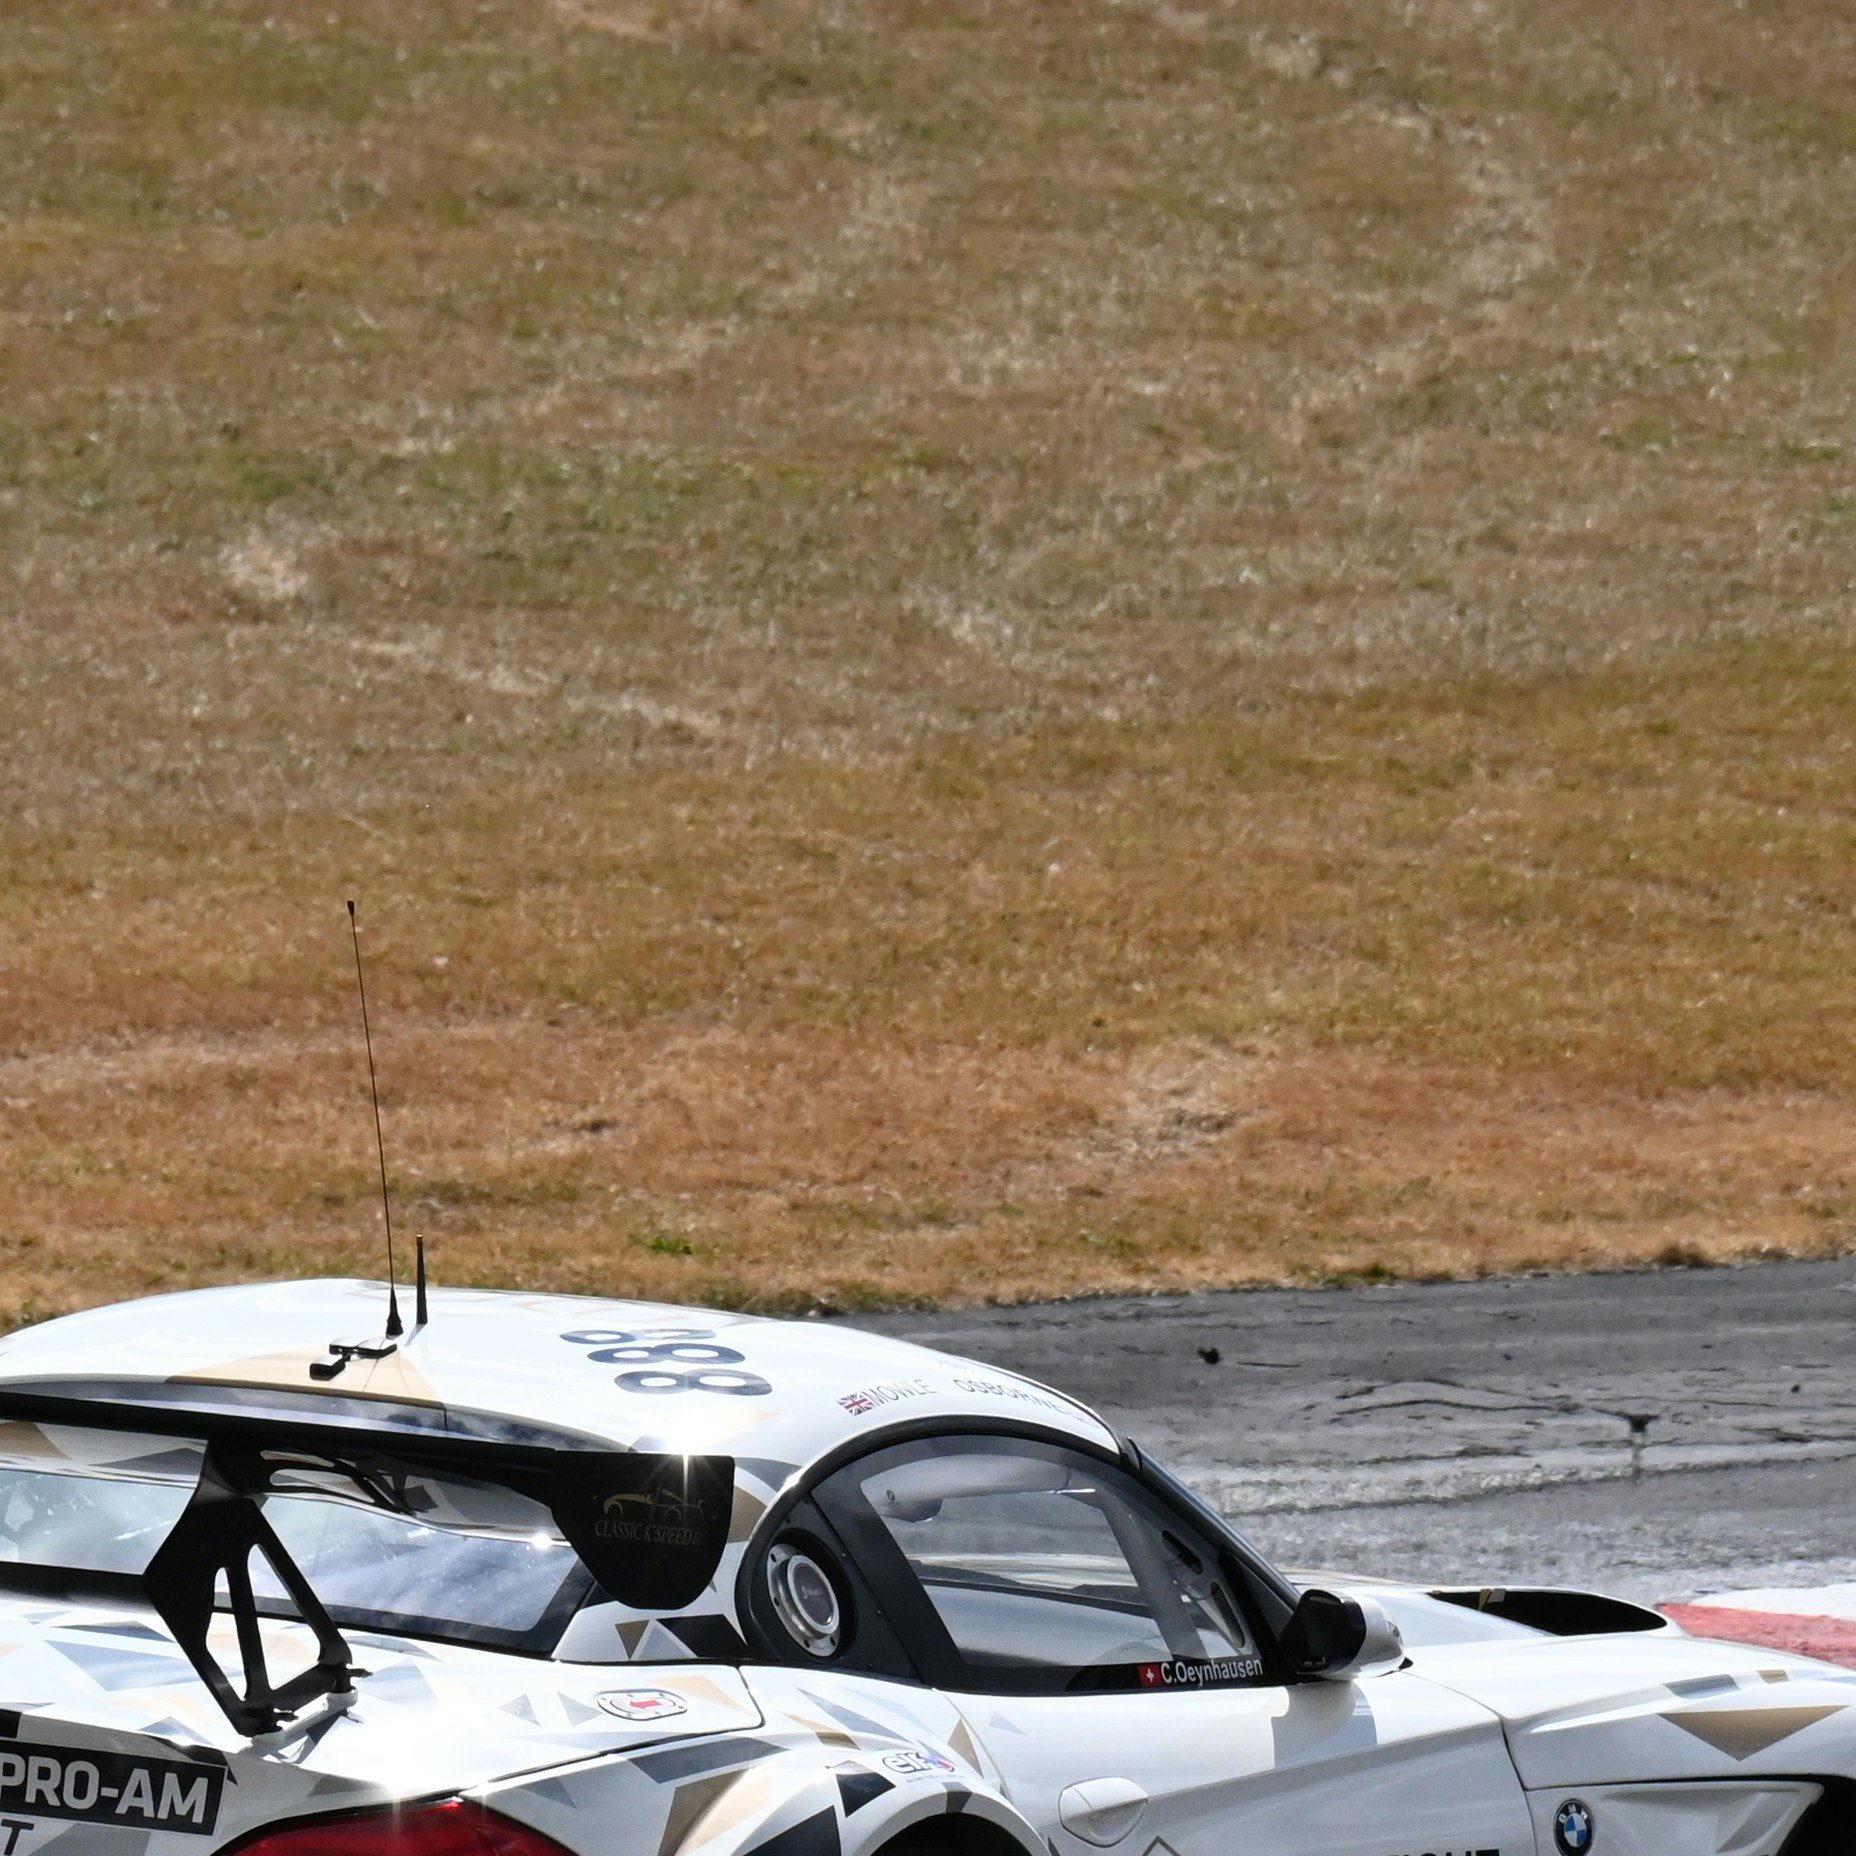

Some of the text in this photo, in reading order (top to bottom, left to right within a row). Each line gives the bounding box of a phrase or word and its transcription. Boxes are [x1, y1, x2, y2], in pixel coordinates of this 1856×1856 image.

[559, 1328, 774, 1396] 888
[860, 1379, 938, 1407] MOWLE
[952, 1379, 1067, 1414] OSBORNE
[594, 1519, 642, 1541] CLASSIC
[643, 1524, 653, 1542] &
[654, 1526, 693, 1545] SPEED
[1160, 1658, 1263, 1687] C.Oeynhausen
[881, 1752, 934, 1774] elf
[1558, 1803, 1588, 1824] BMW
